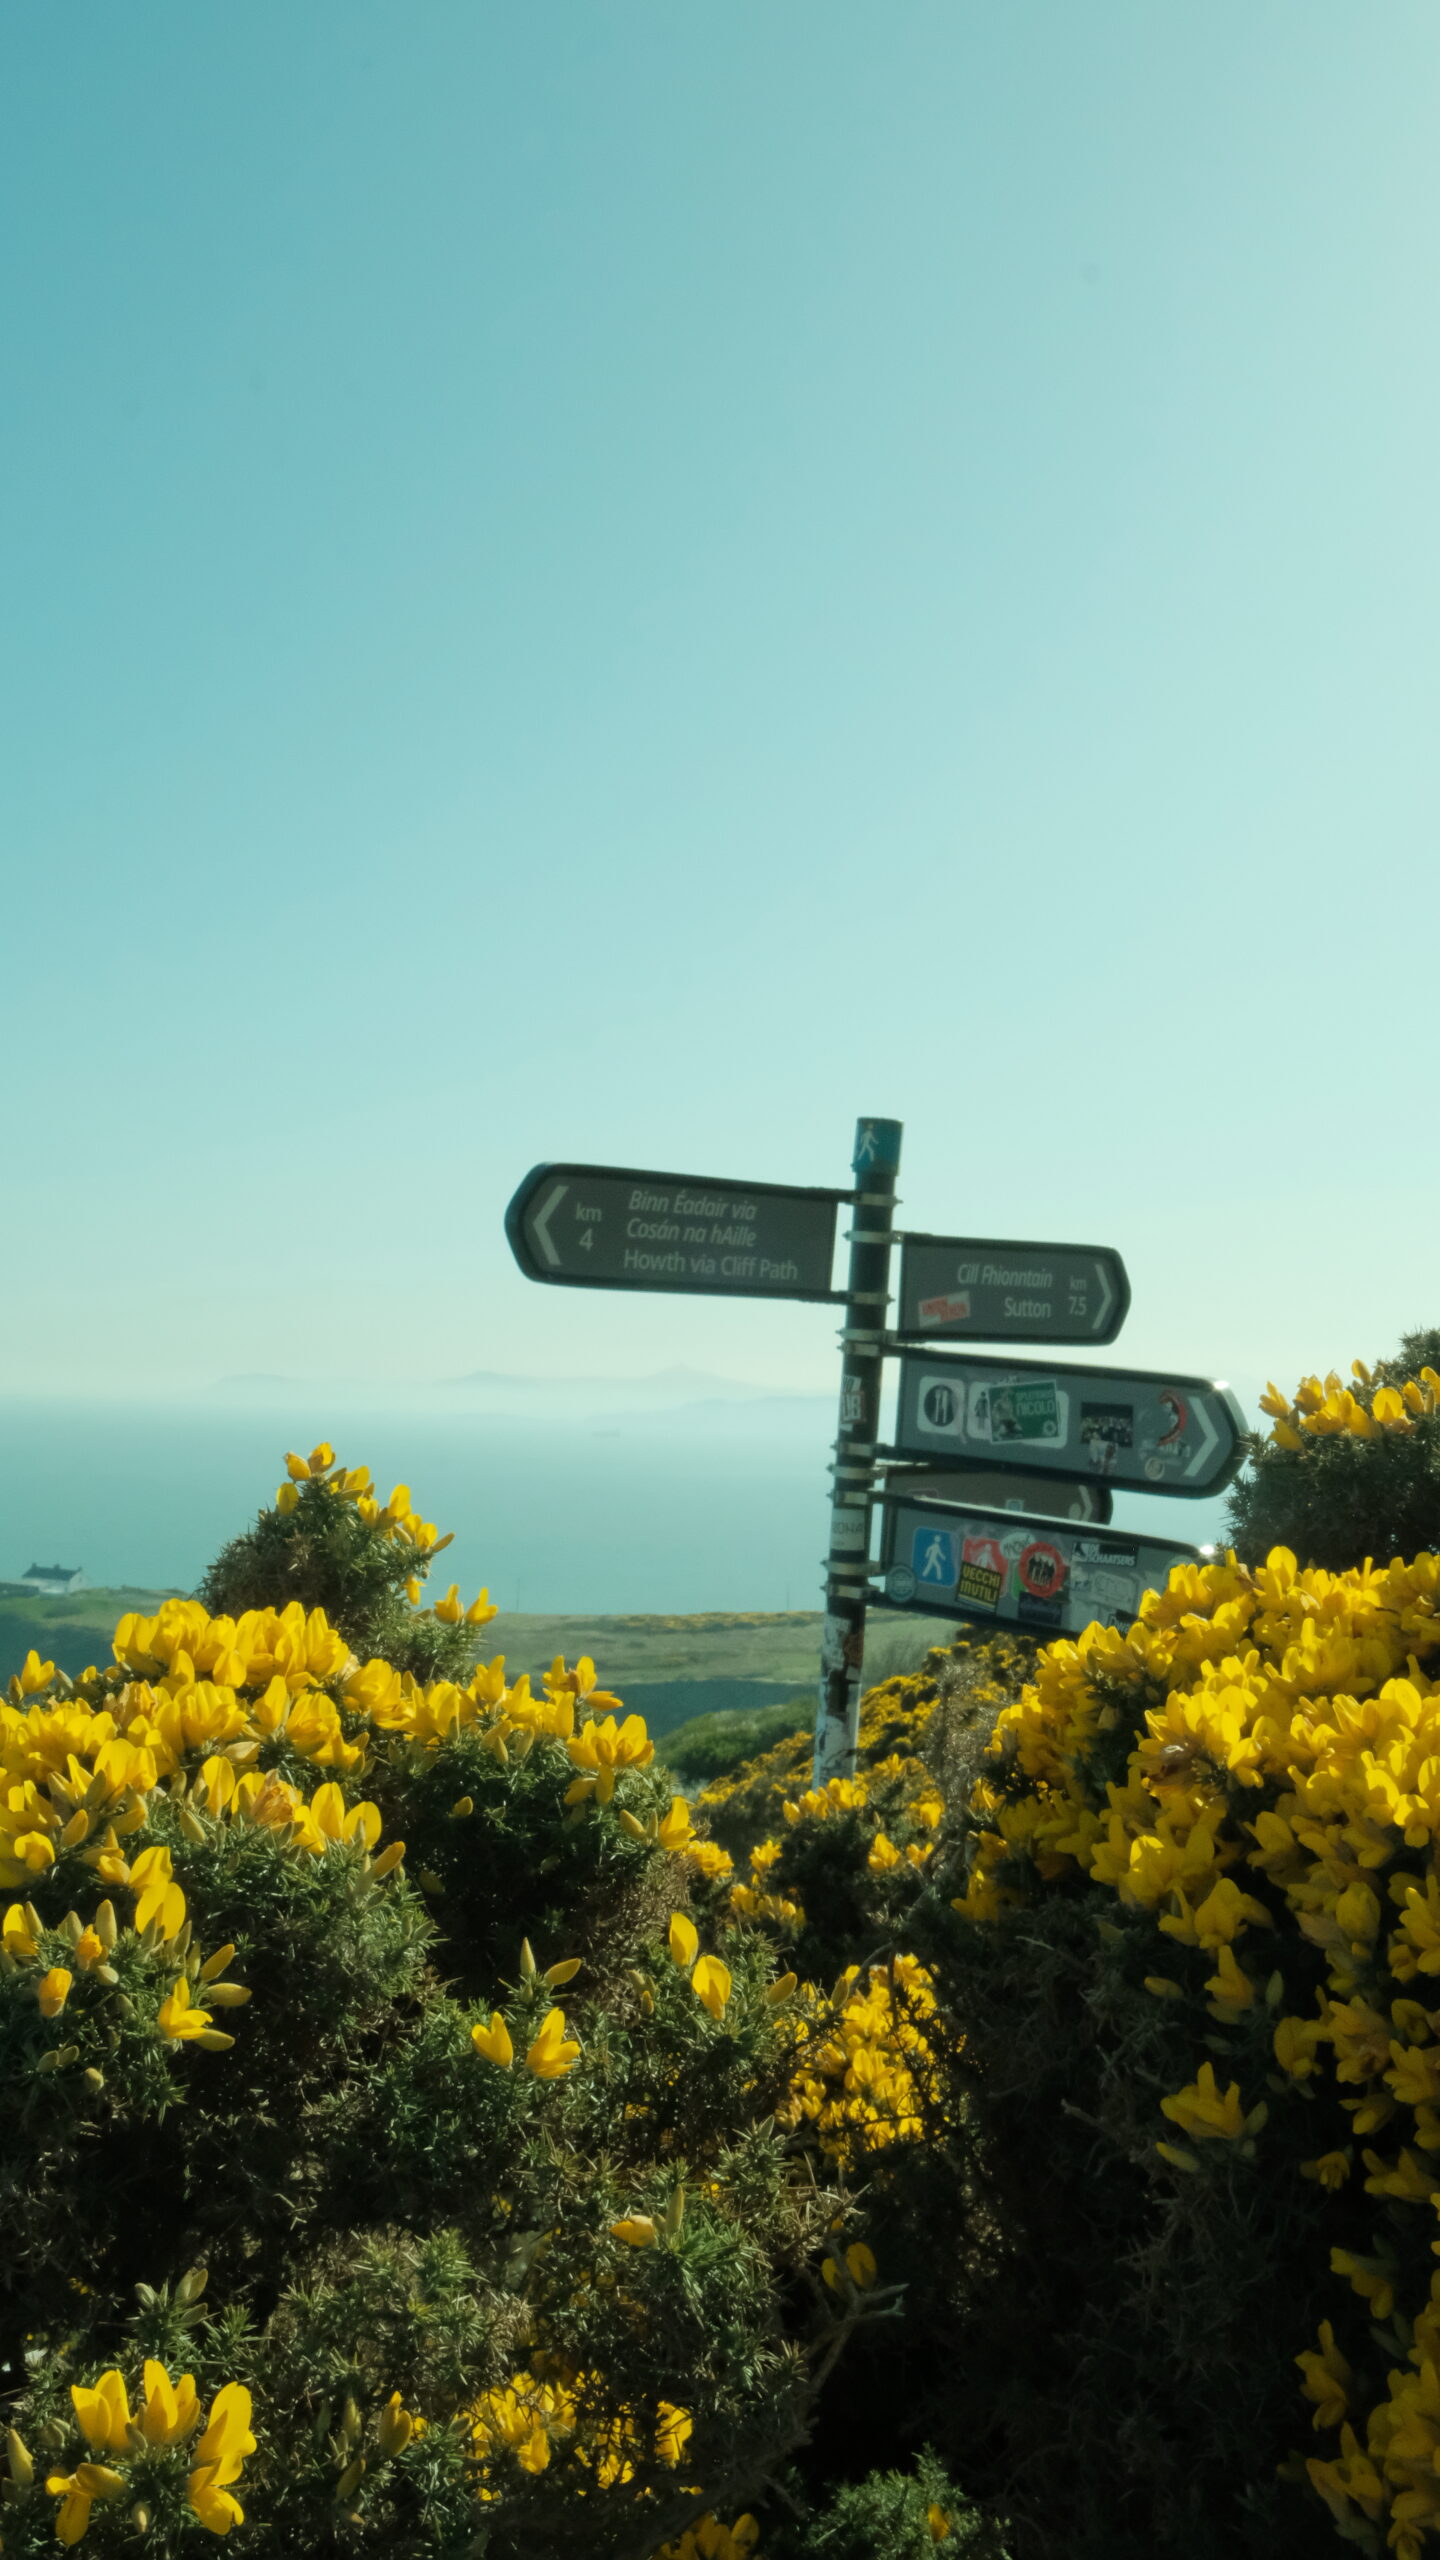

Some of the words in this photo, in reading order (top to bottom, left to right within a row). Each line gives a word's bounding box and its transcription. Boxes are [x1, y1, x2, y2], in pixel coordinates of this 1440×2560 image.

[575, 1203, 602, 1222] km
[628, 1190, 669, 1213] Binn
[673, 1189, 730, 1218] Éadair
[731, 1201, 758, 1221] via
[579, 1229, 593, 1251] 4
[626, 1217, 680, 1241] Cosán
[682, 1226, 707, 1243] na
[709, 1223, 757, 1247] hAille
[623, 1249, 686, 1272] Howth
[690, 1254, 716, 1275] via
[720, 1255, 758, 1277] Cliff
[759, 1258, 799, 1280] Path
[957, 1263, 980, 1285] Cill
[980, 1264, 1053, 1289] Fhionntain
[1069, 1275, 1087, 1292] km
[1003, 1296, 1052, 1318] Sutton
